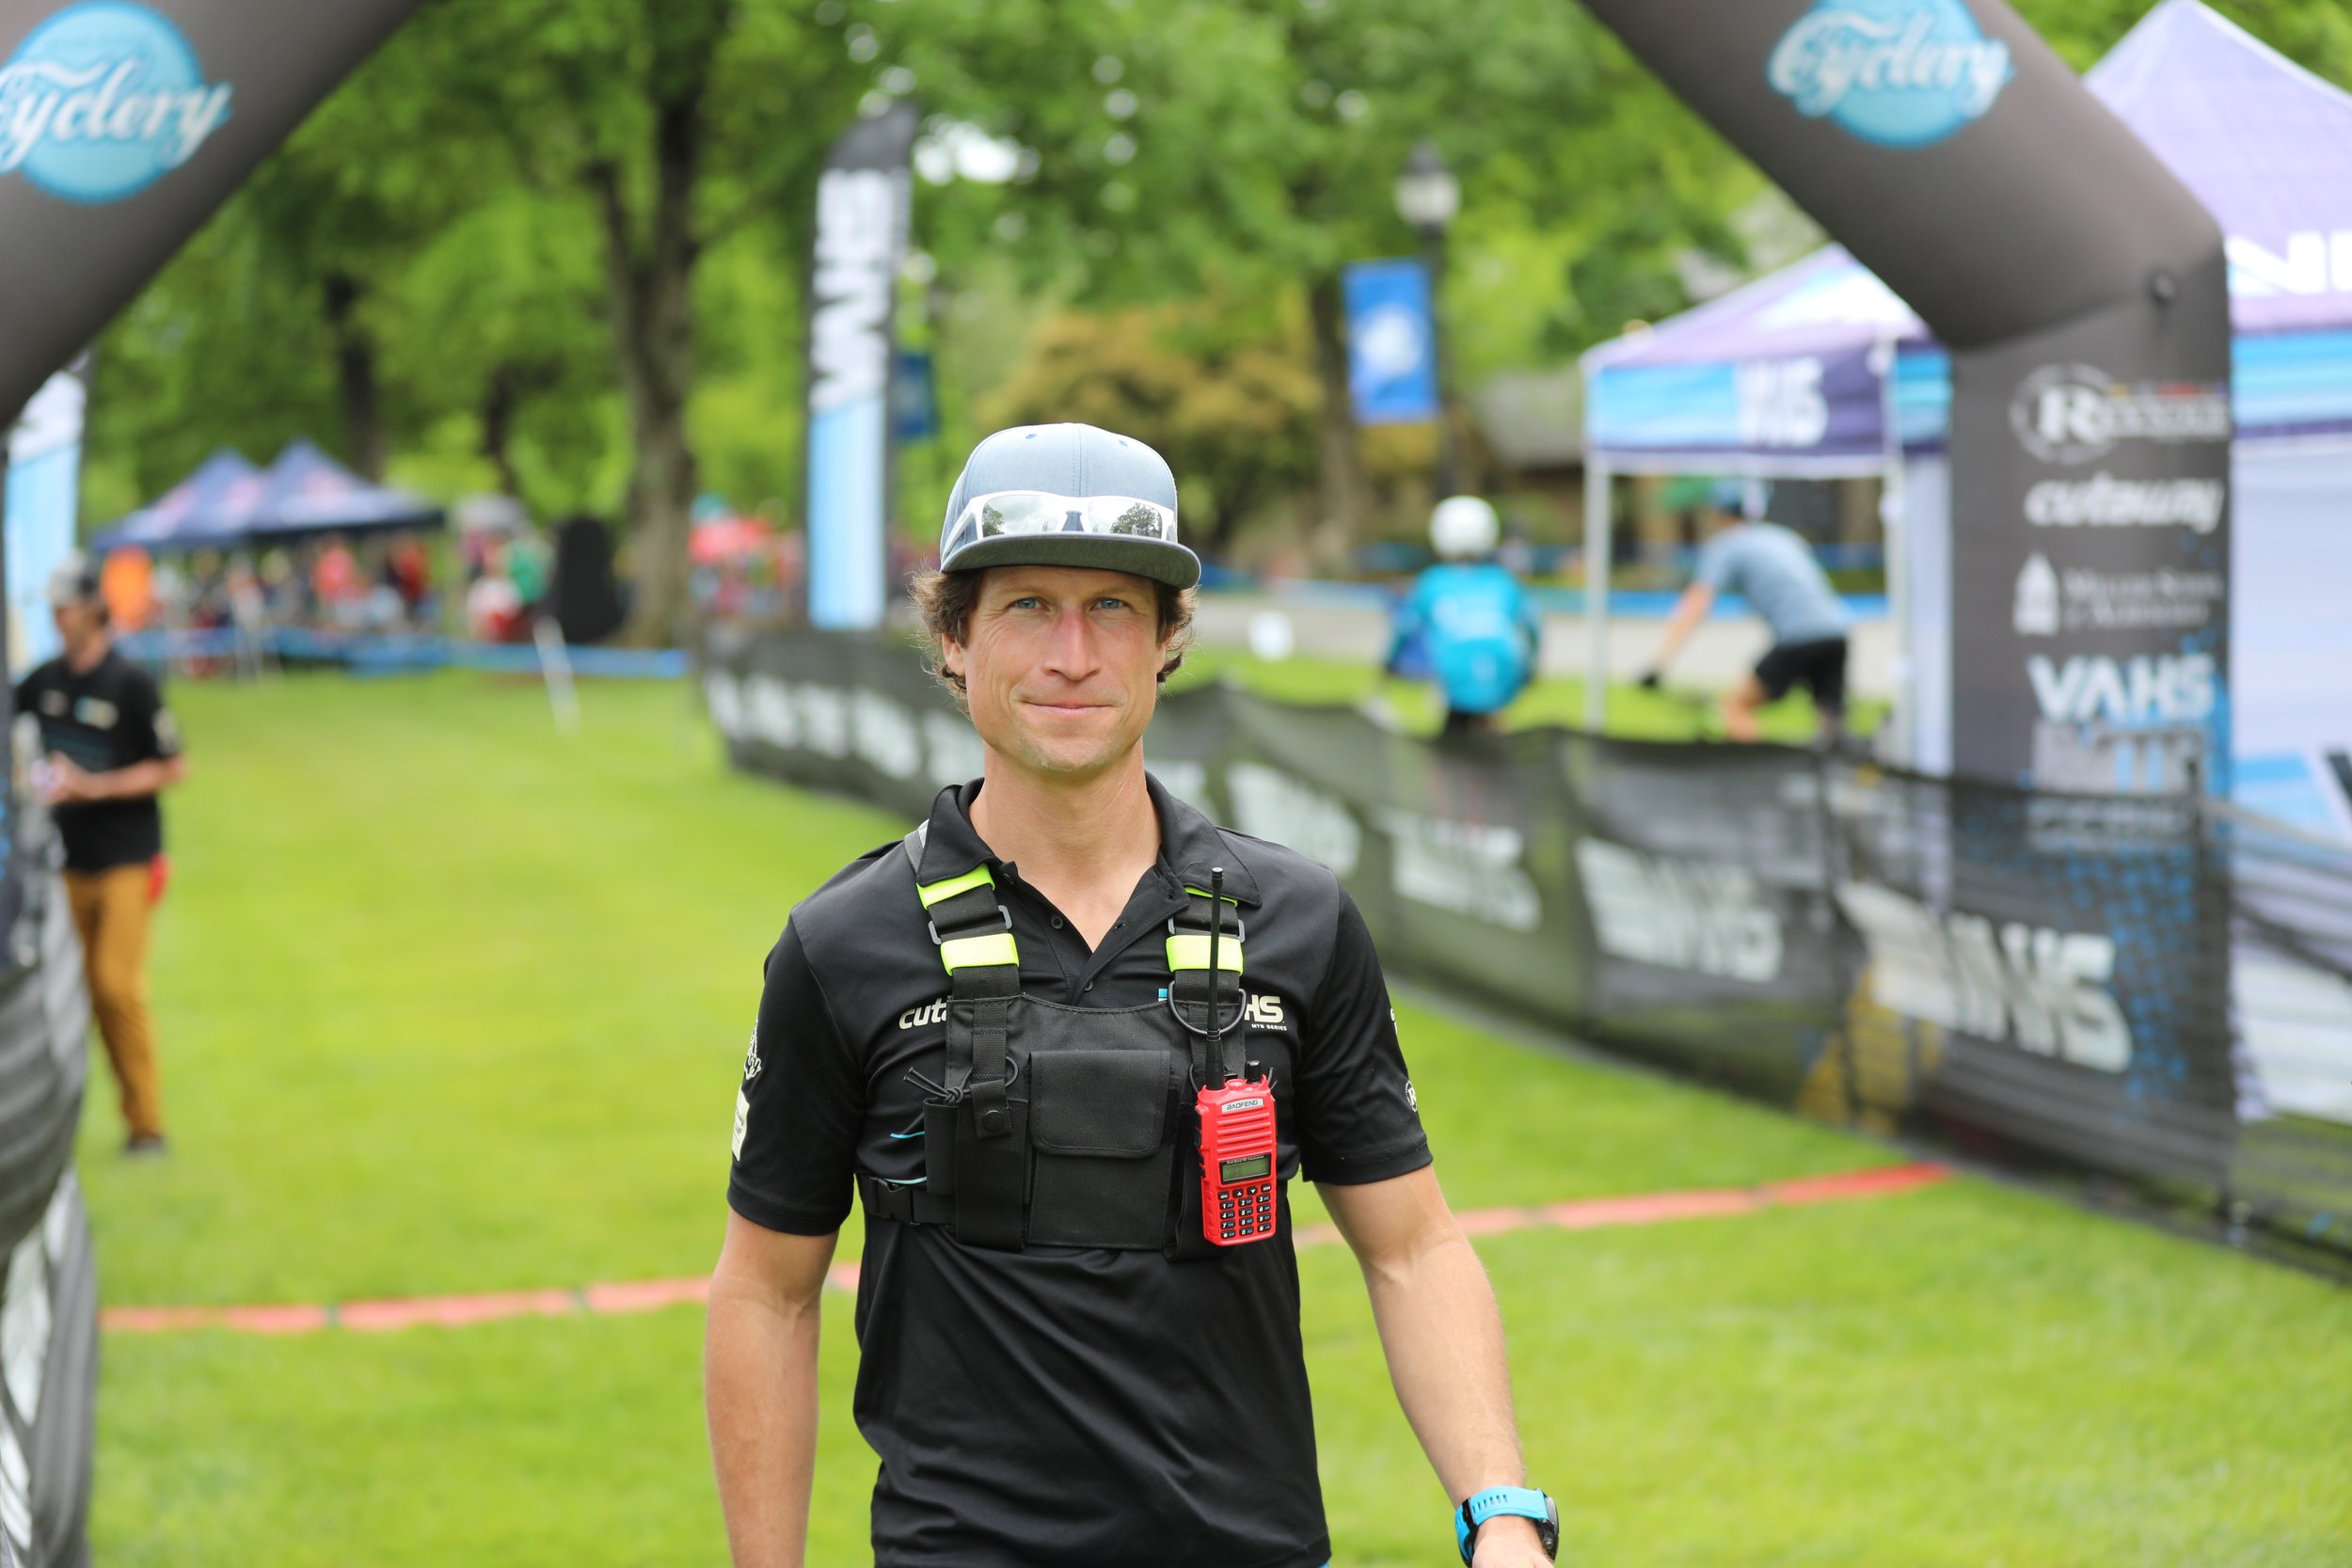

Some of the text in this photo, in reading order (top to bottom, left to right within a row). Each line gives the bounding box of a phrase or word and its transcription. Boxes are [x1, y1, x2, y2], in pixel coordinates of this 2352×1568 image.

[1770, 8, 2011, 118] Cyclery
[2027, 654, 2214, 723] VAHS
[1226, 1099, 1259, 1111] BAOFENG
